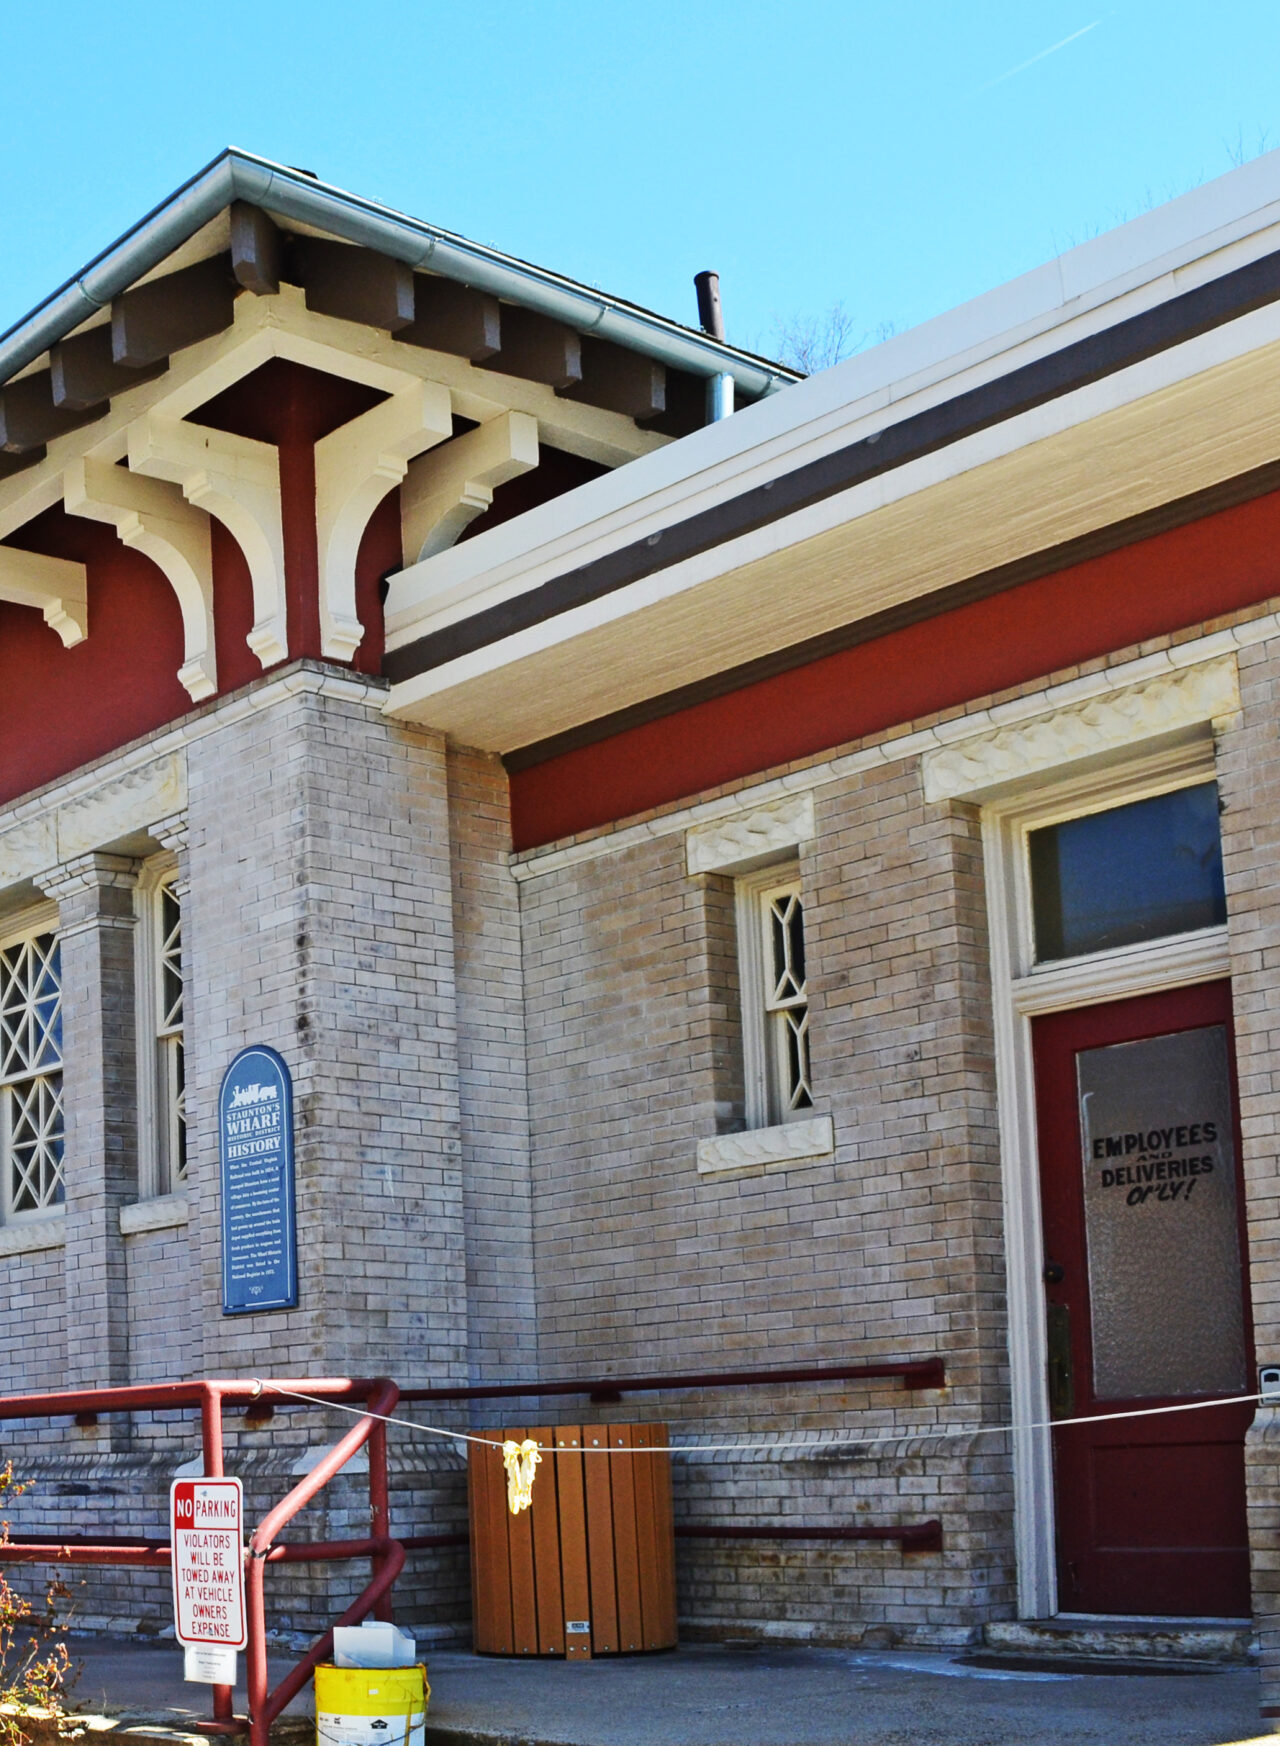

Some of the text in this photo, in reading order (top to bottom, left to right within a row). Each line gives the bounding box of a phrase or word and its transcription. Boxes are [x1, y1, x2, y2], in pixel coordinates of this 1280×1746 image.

[227, 1102, 280, 1121] STAUNTON'S
[227, 1111, 280, 1136] WHARF
[228, 1136, 281, 1158] HISTORY
[1093, 1122, 1218, 1159] EMPLOYEES
[1136, 1151, 1173, 1162] AND
[1101, 1155, 1214, 1188] DELIVERIES
[176, 1499, 237, 1518] NO PARKING
[183, 1533, 231, 1549] VIOLATORS
[190, 1551, 224, 1566] WILL BE
[181, 1568, 235, 1584] TOWED AWAY
[184, 1586, 234, 1602] AT VEHICLE
[192, 1603, 228, 1620] OWNERS
[191, 1621, 231, 1638] EXPENSE
